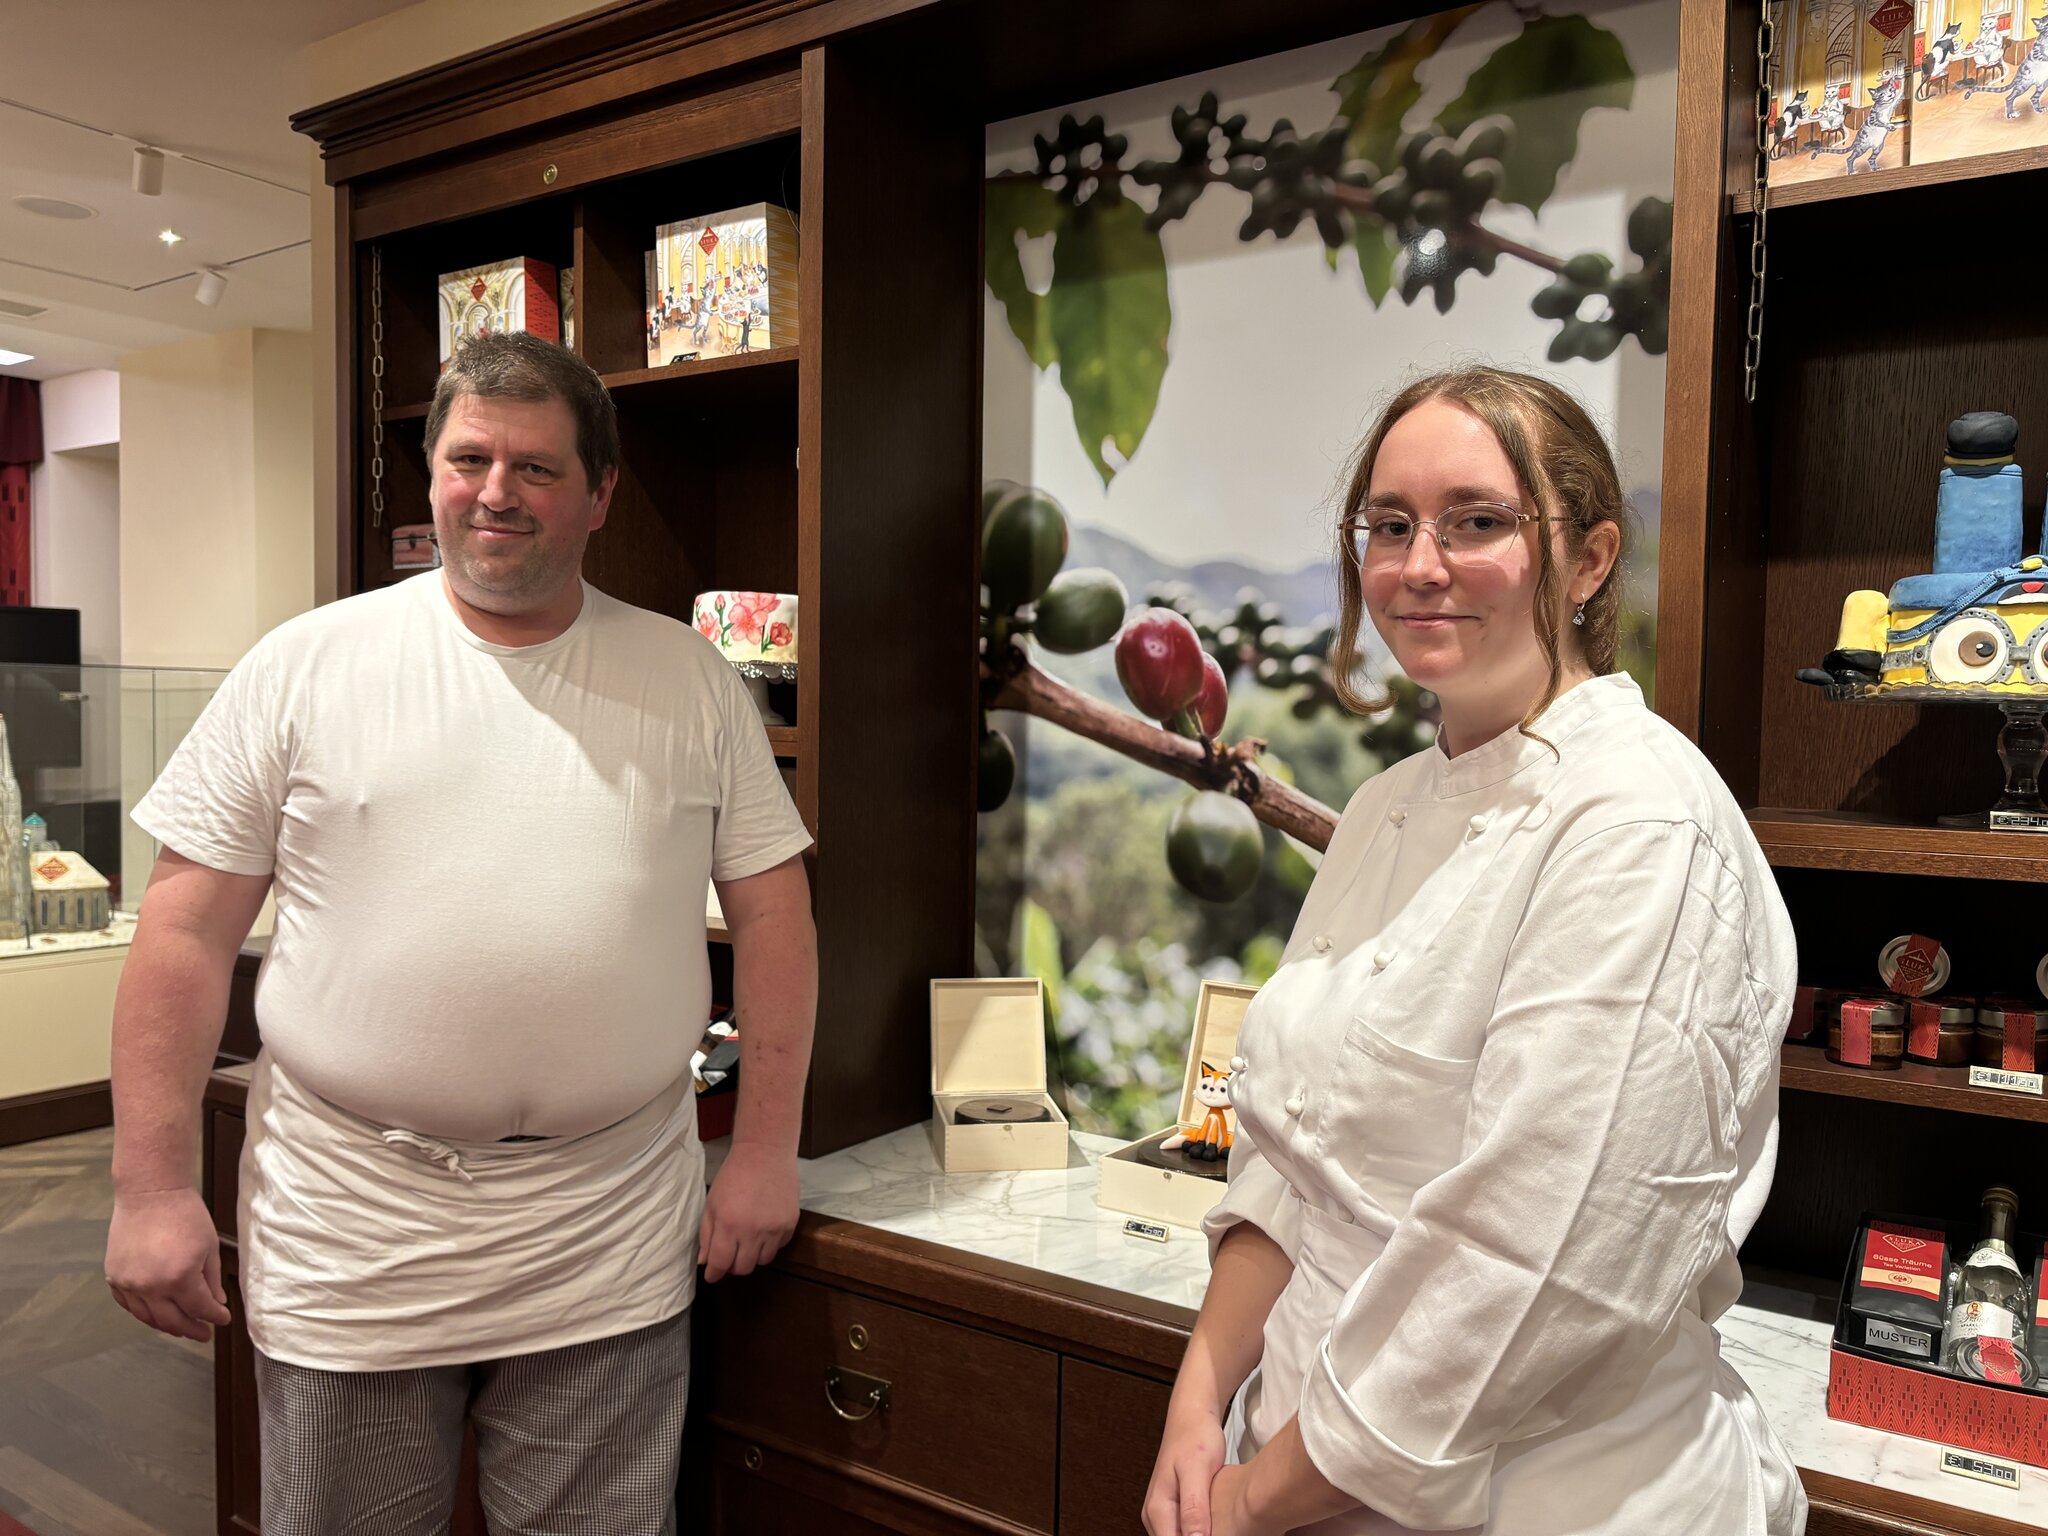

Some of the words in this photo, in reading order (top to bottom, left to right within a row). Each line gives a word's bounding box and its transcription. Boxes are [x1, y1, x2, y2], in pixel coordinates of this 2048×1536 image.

[1874, 10, 1912, 23] SLUKA
[1873, 1253, 1899, 1263] Süsse
[1901, 1258, 1932, 1269] Träume
[1869, 1328, 1928, 1348] MUSTER
